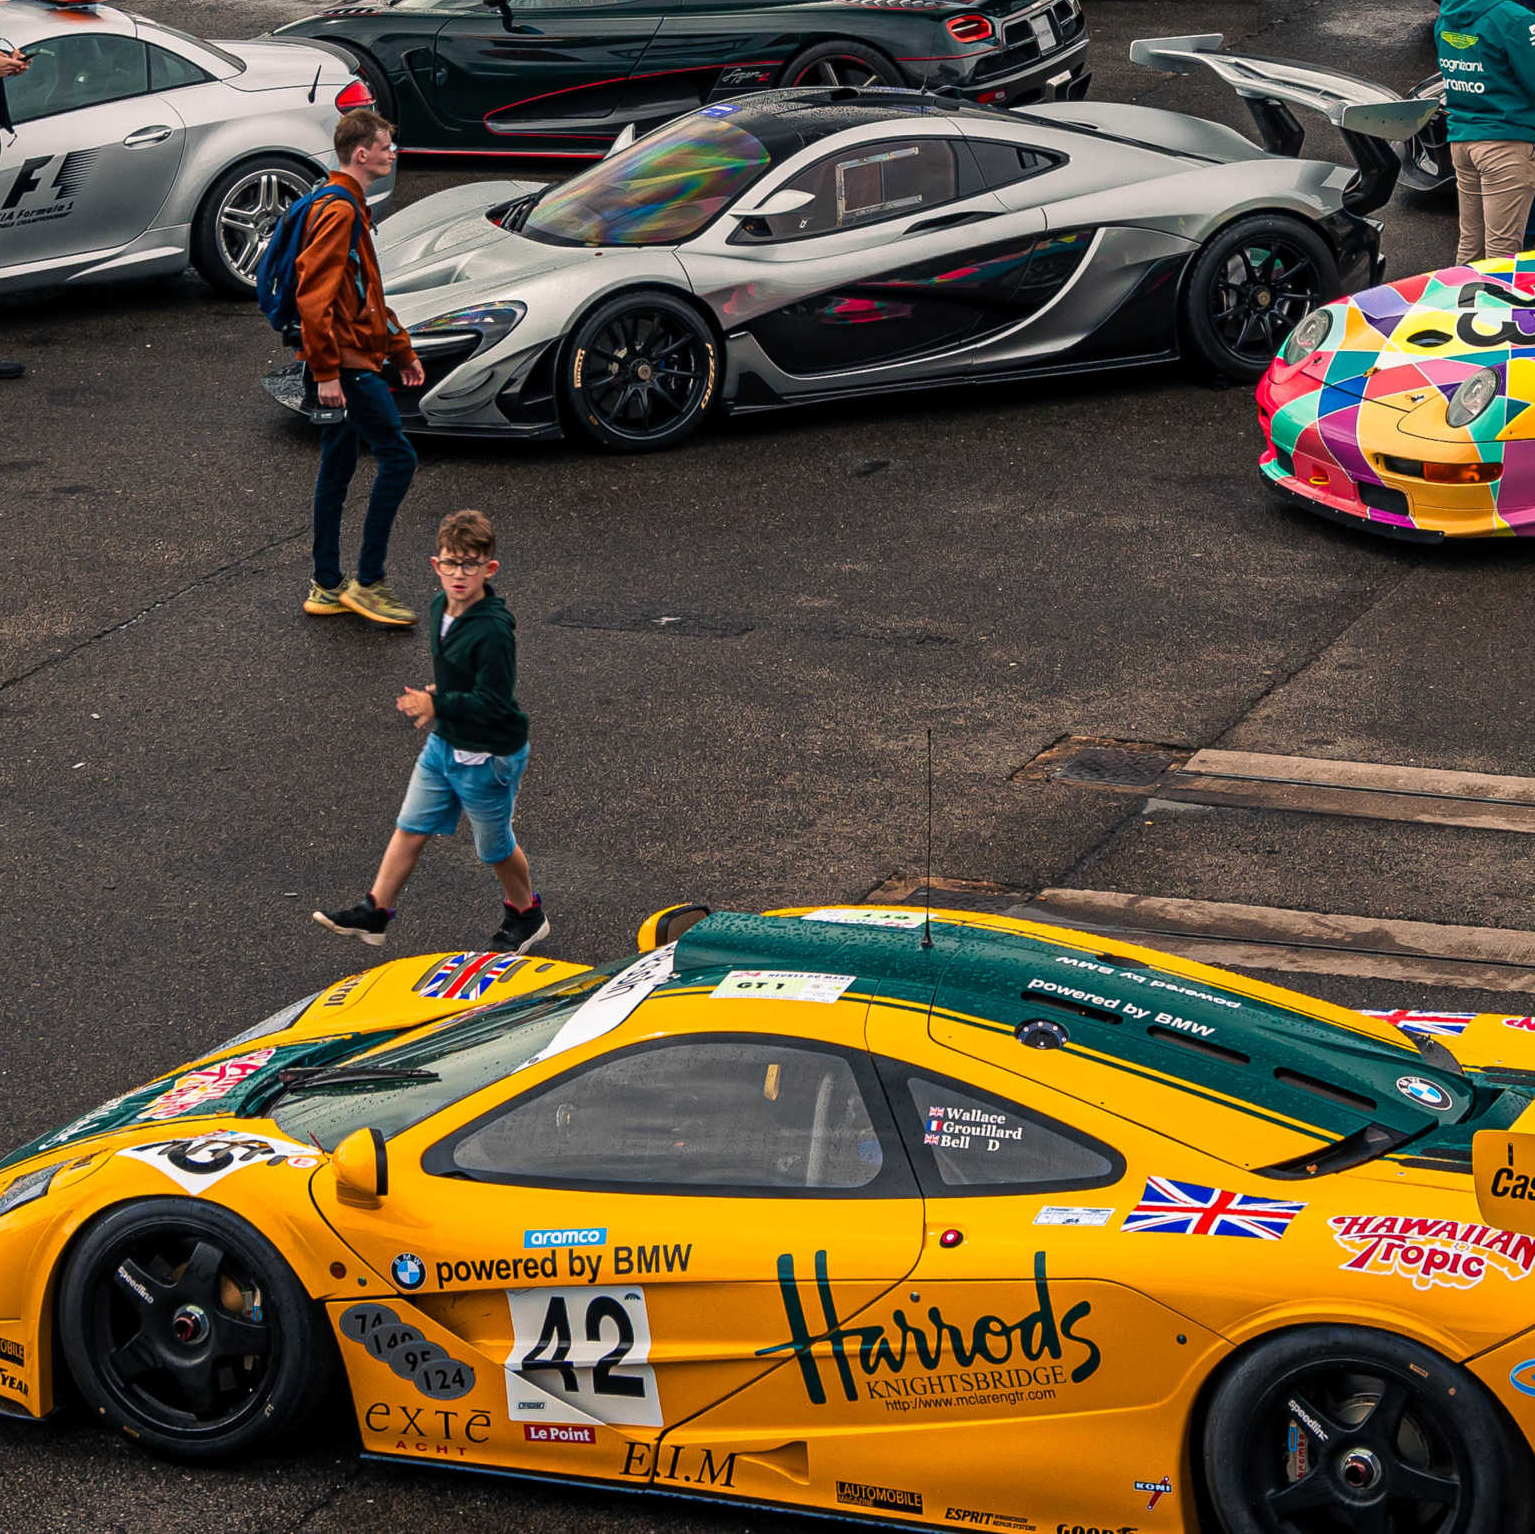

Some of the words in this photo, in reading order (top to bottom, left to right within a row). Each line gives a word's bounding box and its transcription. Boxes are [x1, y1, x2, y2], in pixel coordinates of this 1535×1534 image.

[16, 204, 65, 223] Formula
[737, 980, 769, 992] GT
[1028, 978, 1122, 1010] powered
[1122, 1002, 1150, 1020] by
[1154, 1010, 1216, 1037] BMW
[946, 1108, 1006, 1125] Wallace
[942, 1123, 1023, 1140] Grouillard
[941, 1134, 970, 1149] Bell
[987, 1139, 1000, 1153] D
[531, 1229, 600, 1246] aramco
[436, 1254, 558, 1288] powered
[569, 1249, 603, 1284] by
[614, 1243, 693, 1275] BMW
[1348, 1233, 1486, 1279] Tropic
[755, 1250, 1102, 1405] Harrods
[520, 1295, 647, 1399] 42
[423, 1366, 466, 1392] 124
[866, 1365, 1068, 1401] KNIGHTSBRIDGE
[885, 1386, 1057, 1414] http://www.mclarengtr.com
[530, 1427, 548, 1441] Le
[549, 1427, 591, 1443] Point
[396, 1440, 468, 1457] ACHT
[1136, 1481, 1171, 1494] KONI
[945, 1507, 995, 1526] ESPRIT
